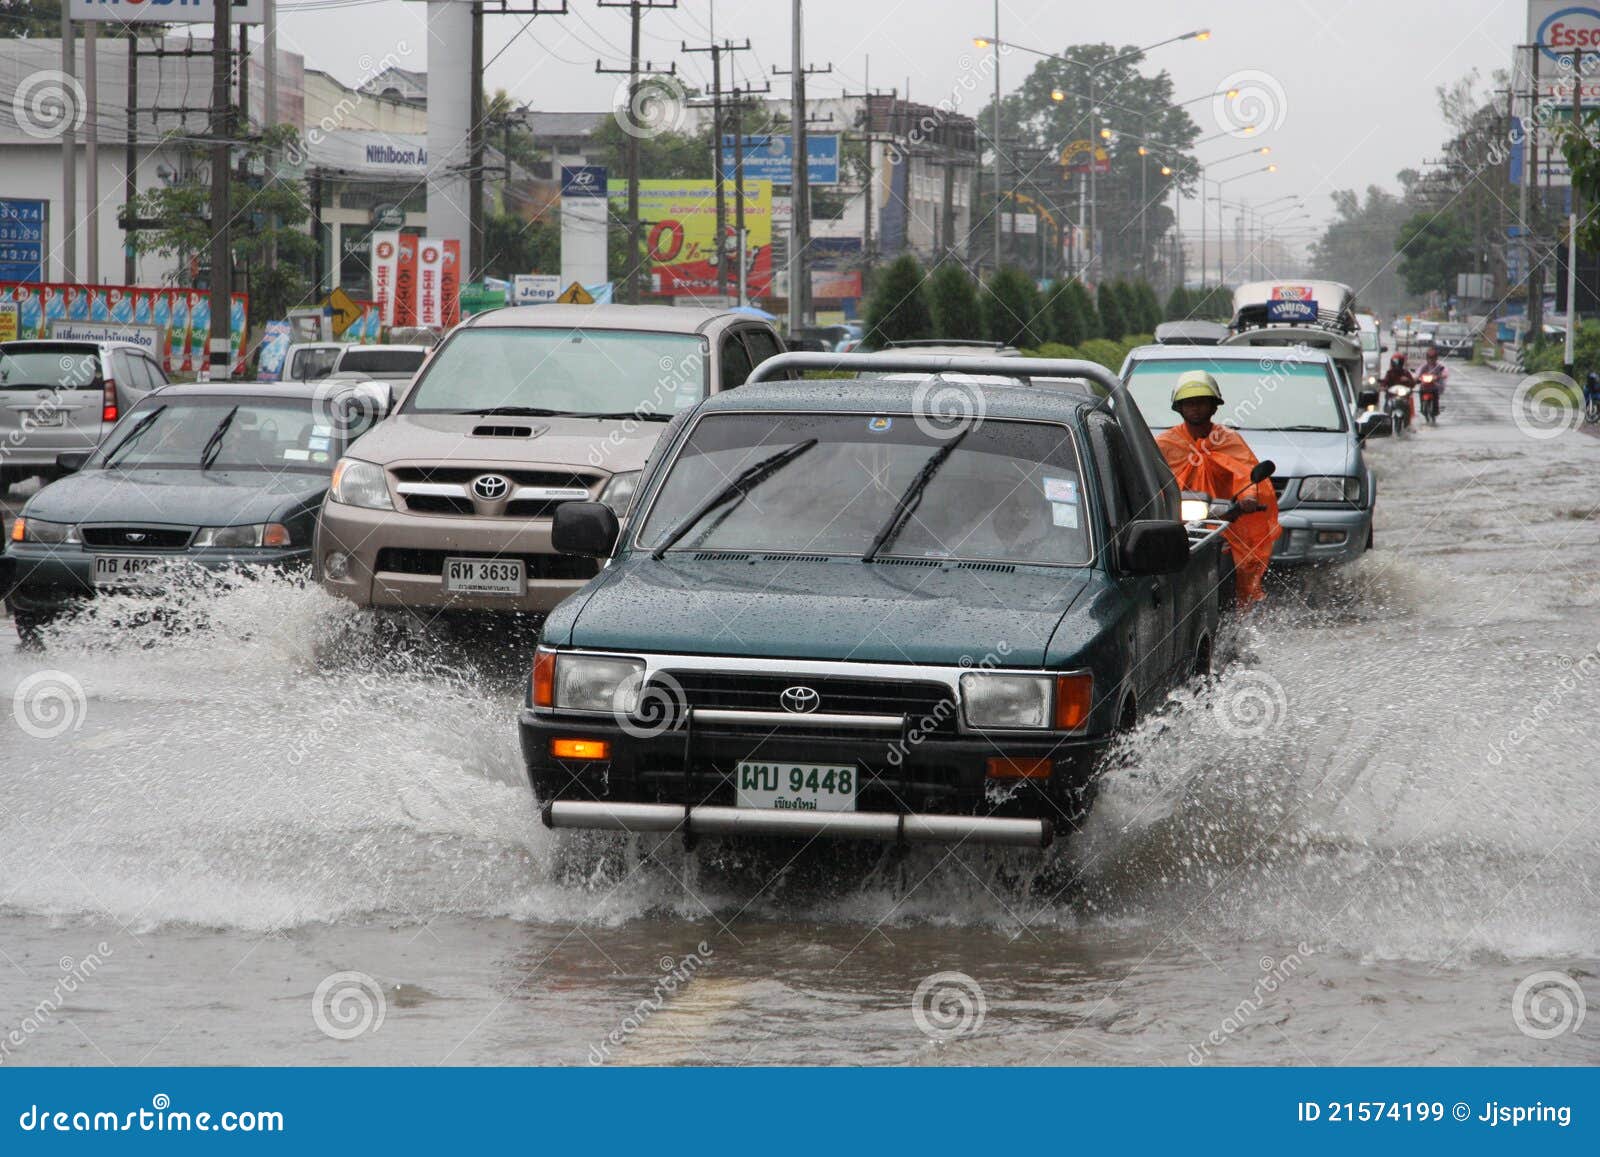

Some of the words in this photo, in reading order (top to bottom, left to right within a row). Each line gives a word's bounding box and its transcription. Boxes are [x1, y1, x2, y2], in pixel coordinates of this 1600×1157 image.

[417, 147, 427, 165] A
[521, 287, 555, 299] Jeep
[480, 564, 519, 581] 3639
[789, 767, 852, 794] 9448
[774, 796, 817, 810] เชียงใหม่
